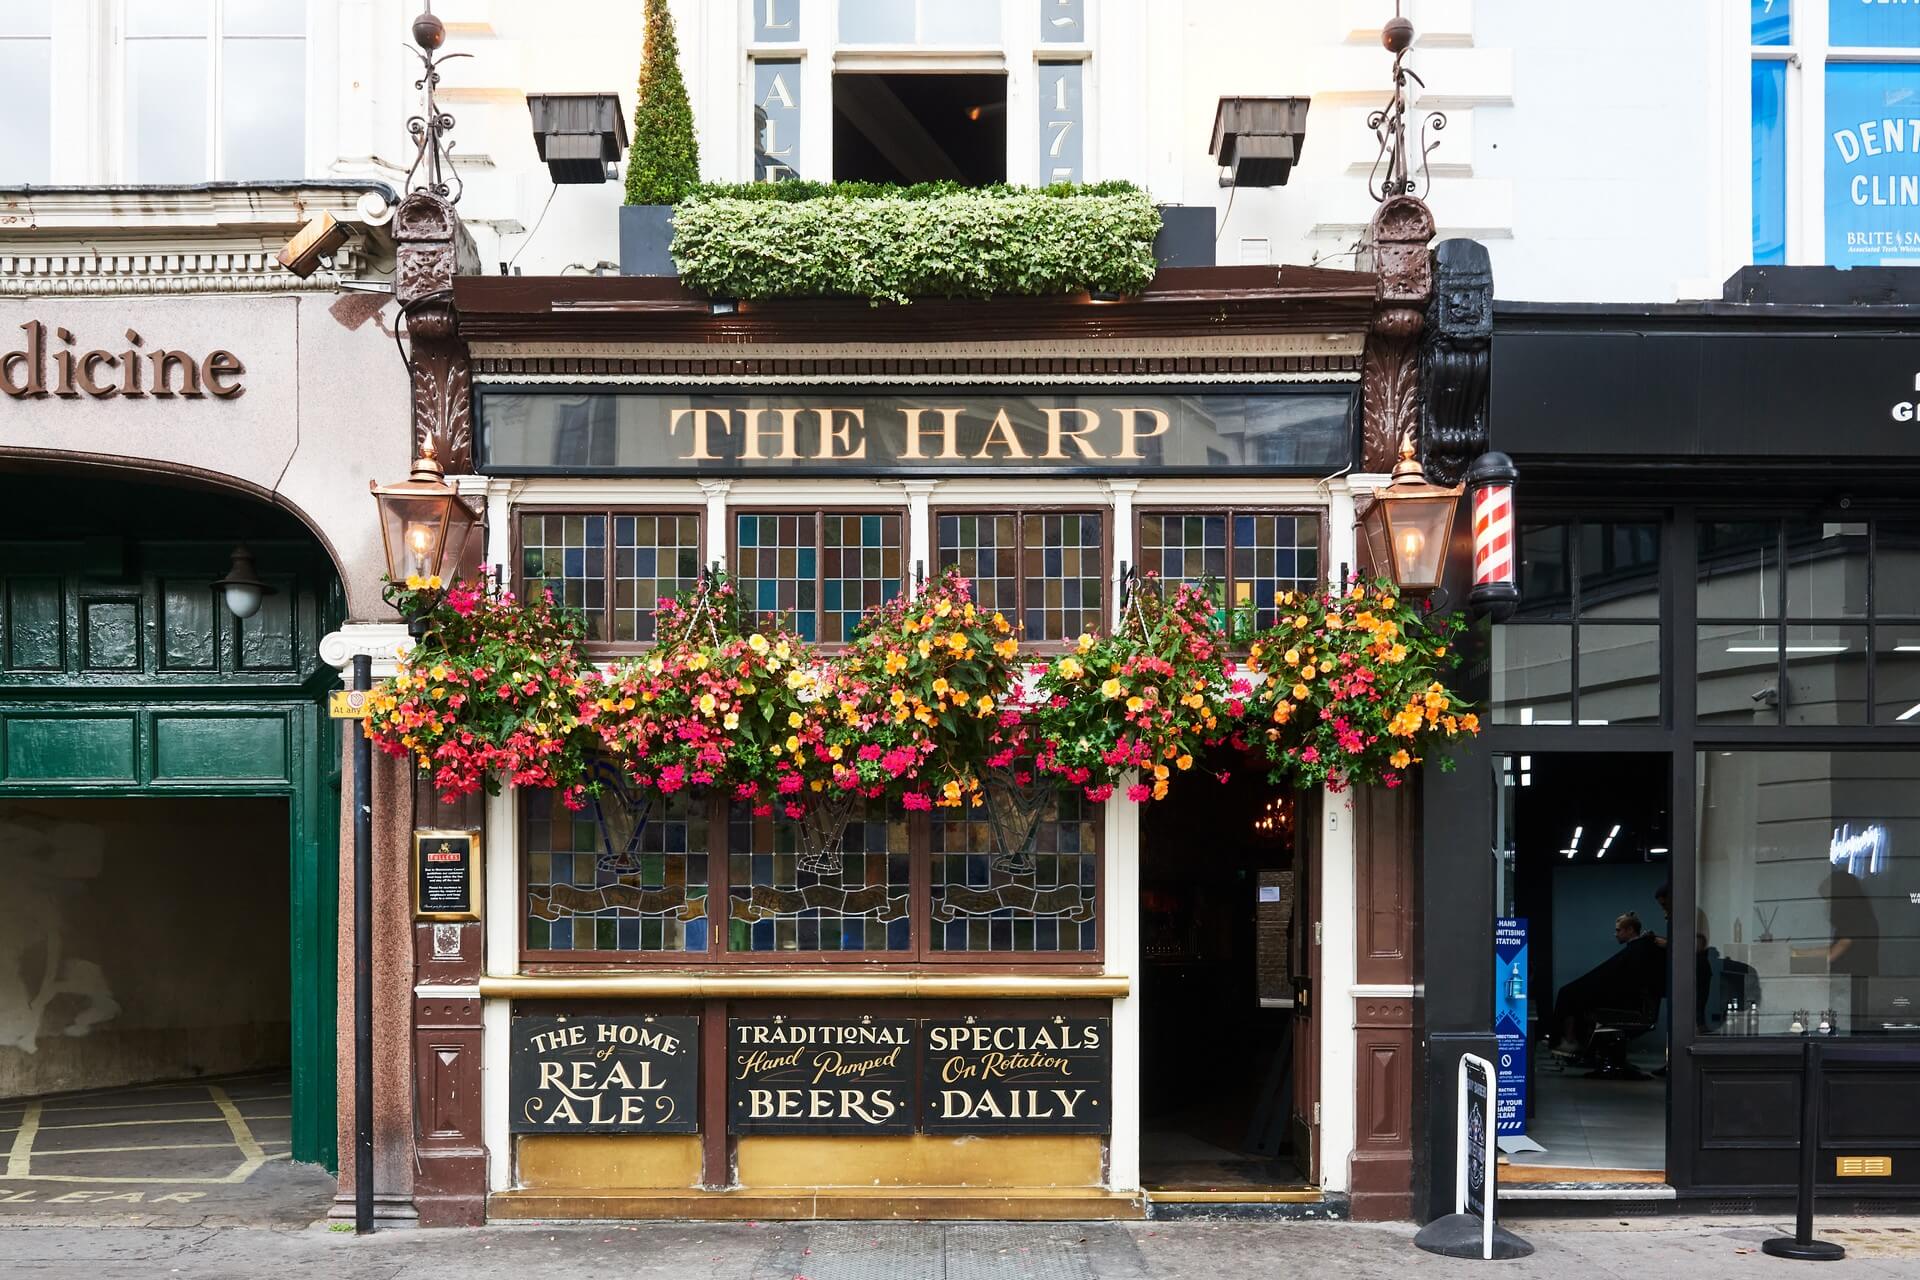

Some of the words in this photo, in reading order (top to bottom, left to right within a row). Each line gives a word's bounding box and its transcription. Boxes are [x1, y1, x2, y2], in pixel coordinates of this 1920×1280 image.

[1832, 118, 1920, 165] DENT
[1851, 174, 1919, 207] CLIN
[1846, 231, 1893, 246] BRITE
[0, 319, 242, 396] dicine
[1892, 401, 1920, 422] G
[669, 406, 867, 461] THE
[895, 406, 1171, 461] HARP
[530, 1025, 587, 1053] THE
[597, 1024, 680, 1056] HOME
[736, 1026, 910, 1044] TRADITIONAL
[929, 1025, 1100, 1051] SPECIALS
[596, 1044, 616, 1061] of
[736, 1046, 805, 1080] Hand
[811, 1046, 902, 1085] Pumped
[942, 1055, 977, 1083] On
[981, 1051, 1073, 1081] Rotation
[538, 1060, 667, 1101] REAL
[543, 1095, 646, 1124] ALE
[748, 1089, 895, 1124] BEERS
[940, 1088, 1086, 1118] DAILY
[0, 1190, 208, 1203] LEAR
